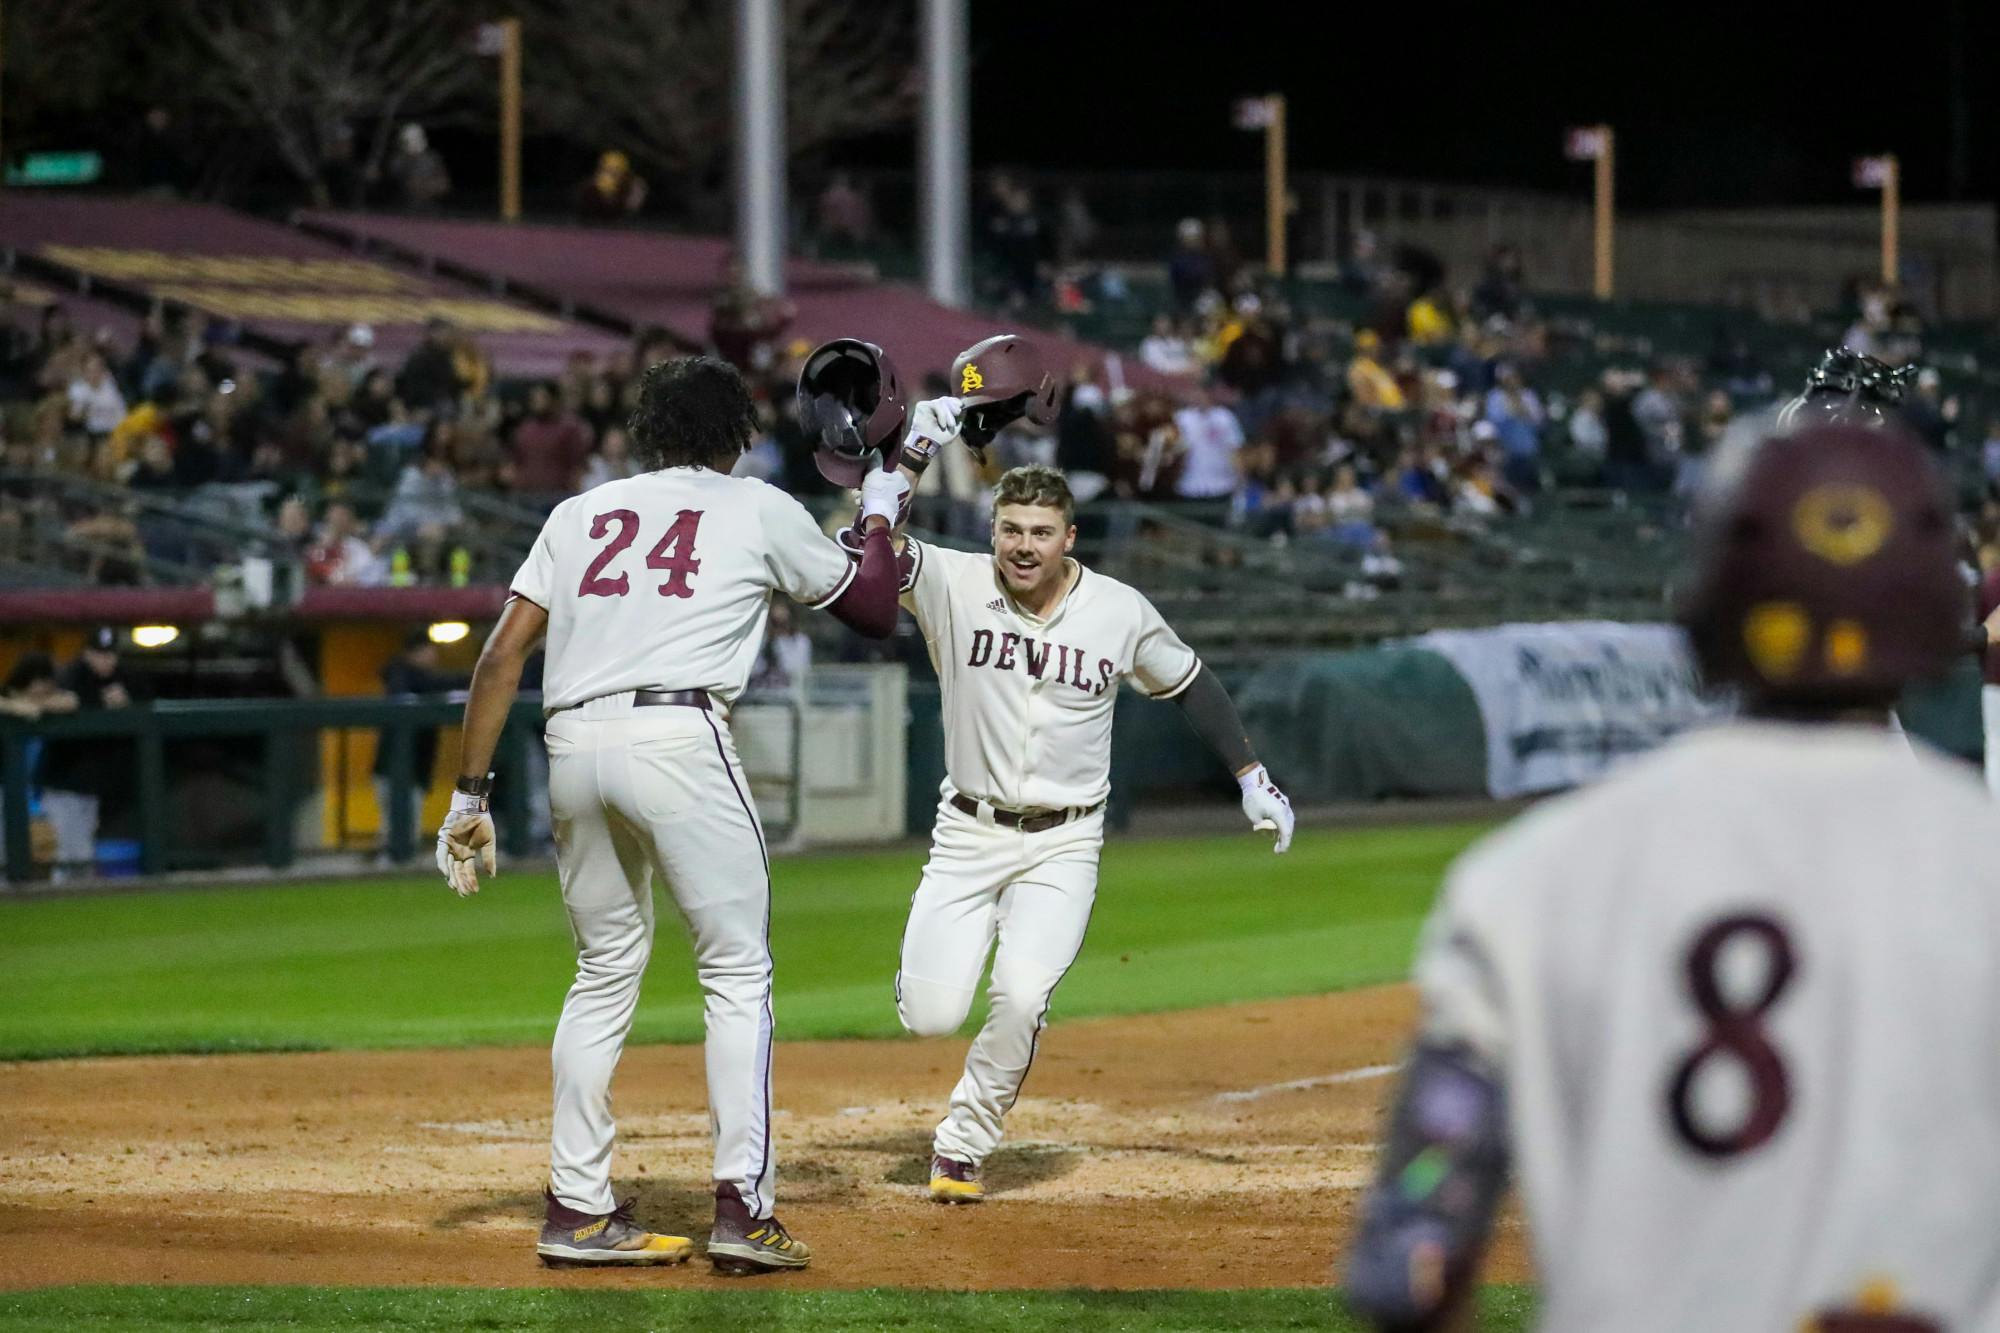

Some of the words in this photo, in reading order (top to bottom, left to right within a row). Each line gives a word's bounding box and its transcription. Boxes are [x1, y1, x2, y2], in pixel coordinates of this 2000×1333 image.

[578, 509, 705, 598] 24
[985, 602, 1008, 615] adidas
[967, 629, 1114, 696] DEVILS
[1668, 913, 1796, 1157] 8
